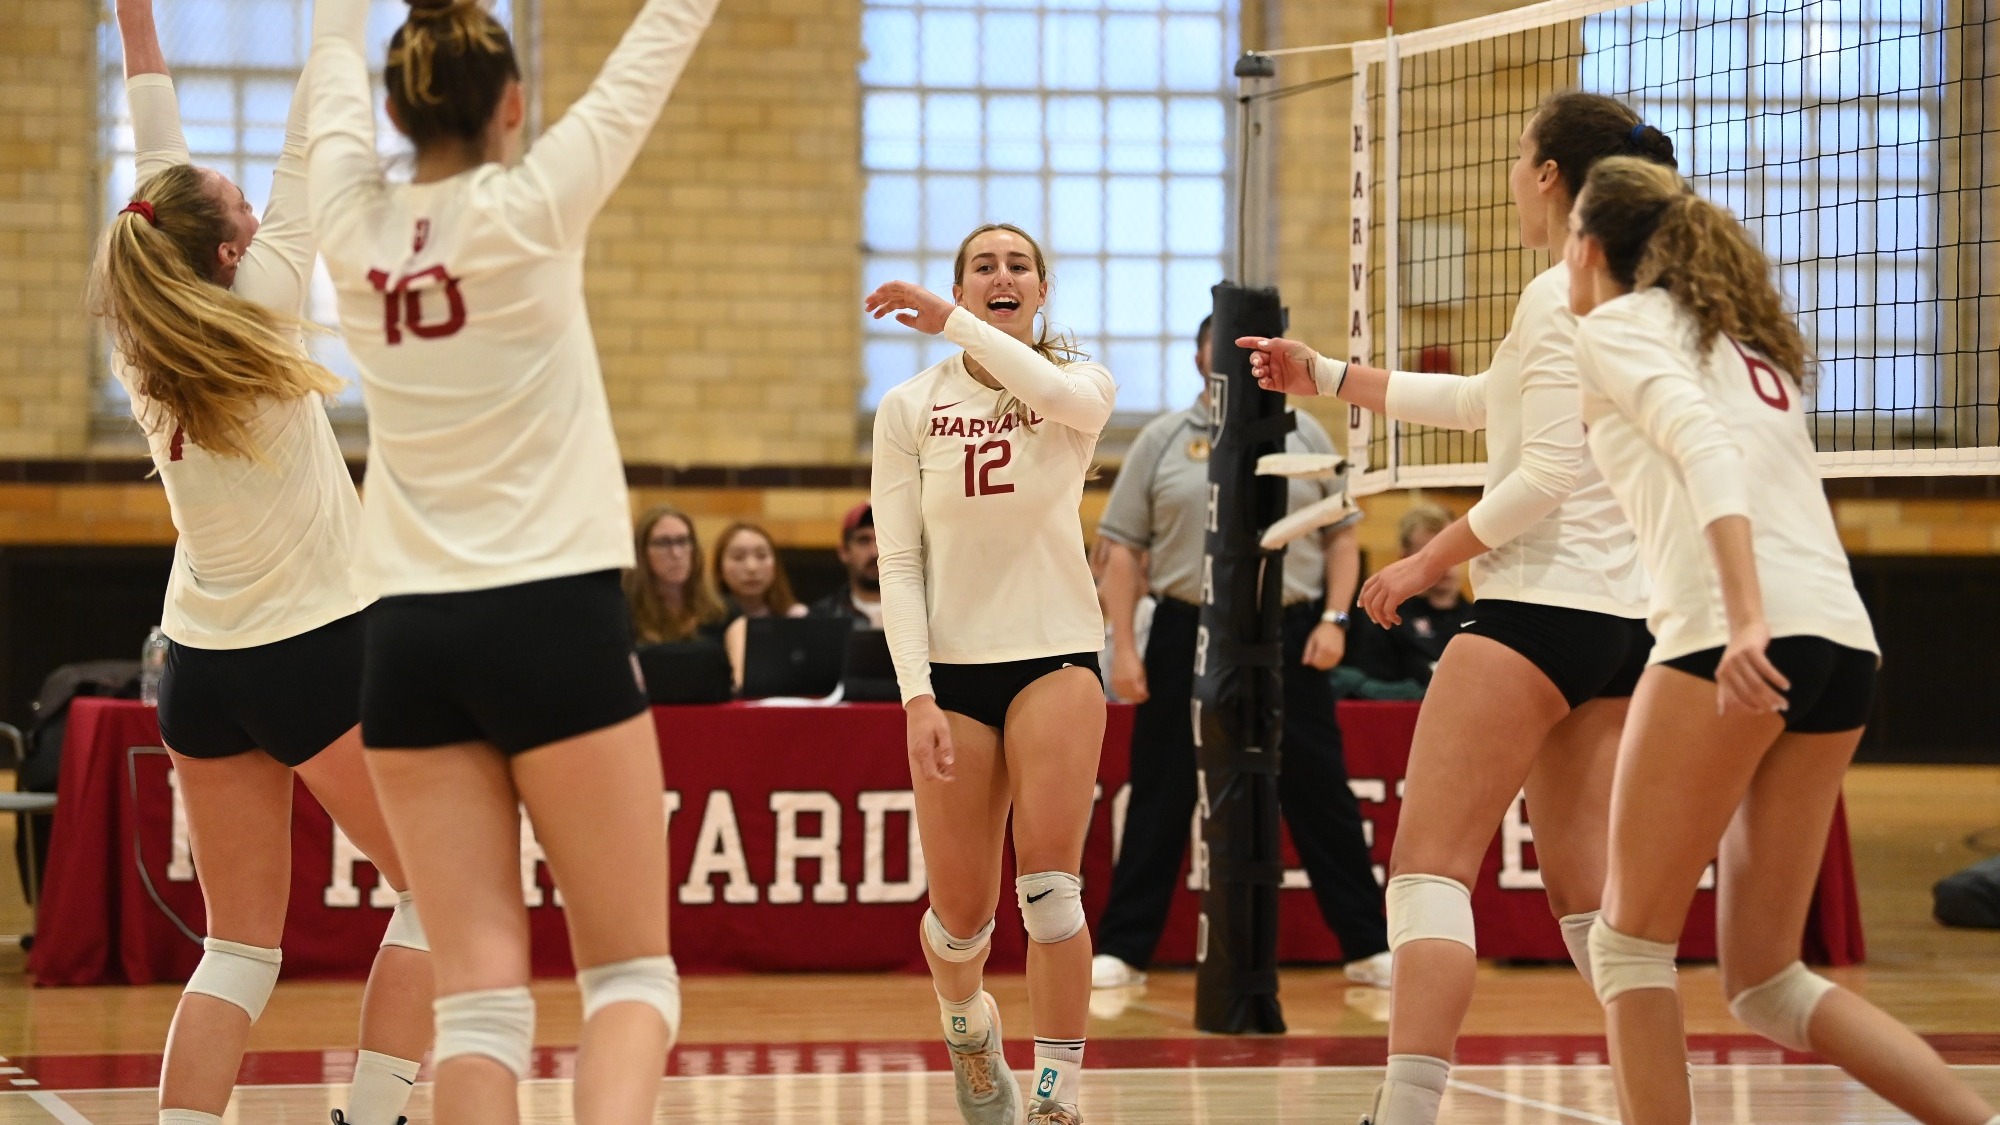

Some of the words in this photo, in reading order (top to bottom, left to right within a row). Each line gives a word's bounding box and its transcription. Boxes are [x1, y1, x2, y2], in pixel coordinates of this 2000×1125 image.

[367, 264, 466, 345] 10
[1350, 125, 1363, 430] HARVAD
[964, 439, 1015, 497] 12
